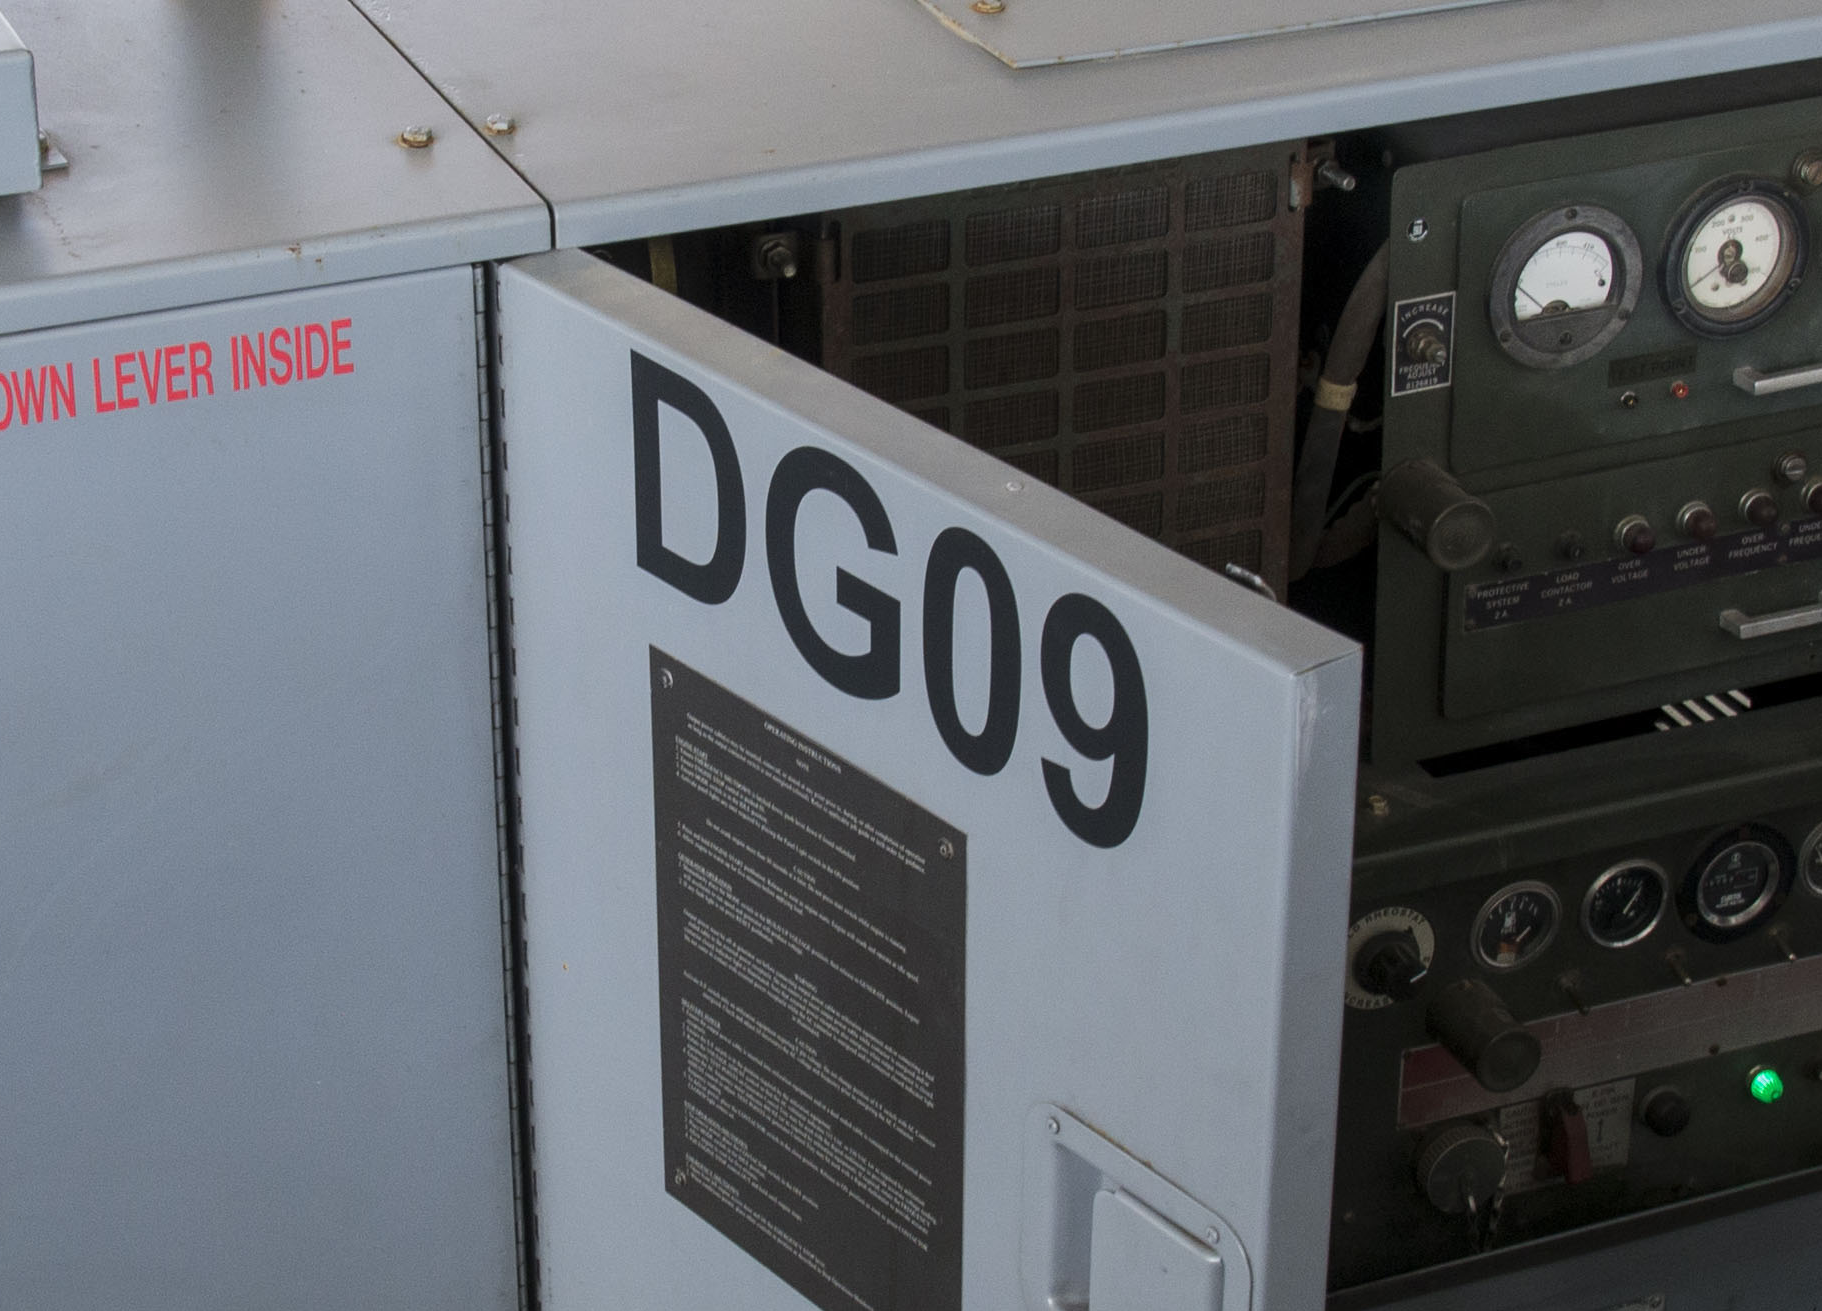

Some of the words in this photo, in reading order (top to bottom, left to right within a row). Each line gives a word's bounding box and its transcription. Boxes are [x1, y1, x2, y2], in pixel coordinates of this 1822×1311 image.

[1401, 303, 1449, 323] INCREASE
[93, 341, 214, 414] LEVER
[230, 318, 356, 392] INSIDE
[1677, 546, 1706, 560] UNDER
[1729, 542, 1778, 560] FREQUENCY
[1618, 559, 1641, 572] OVER
[1674, 556, 1711, 572] VOLTAGE
[1556, 571, 1580, 585] LOAD
[1611, 569, 1648, 585] VOLTAGE
[1476, 583, 1529, 599] PROTECTIVE
[1541, 581, 1593, 599] CONTACTOR
[630, 349, 1149, 849] DG09
[1485, 597, 1521, 611] SYSTEM
